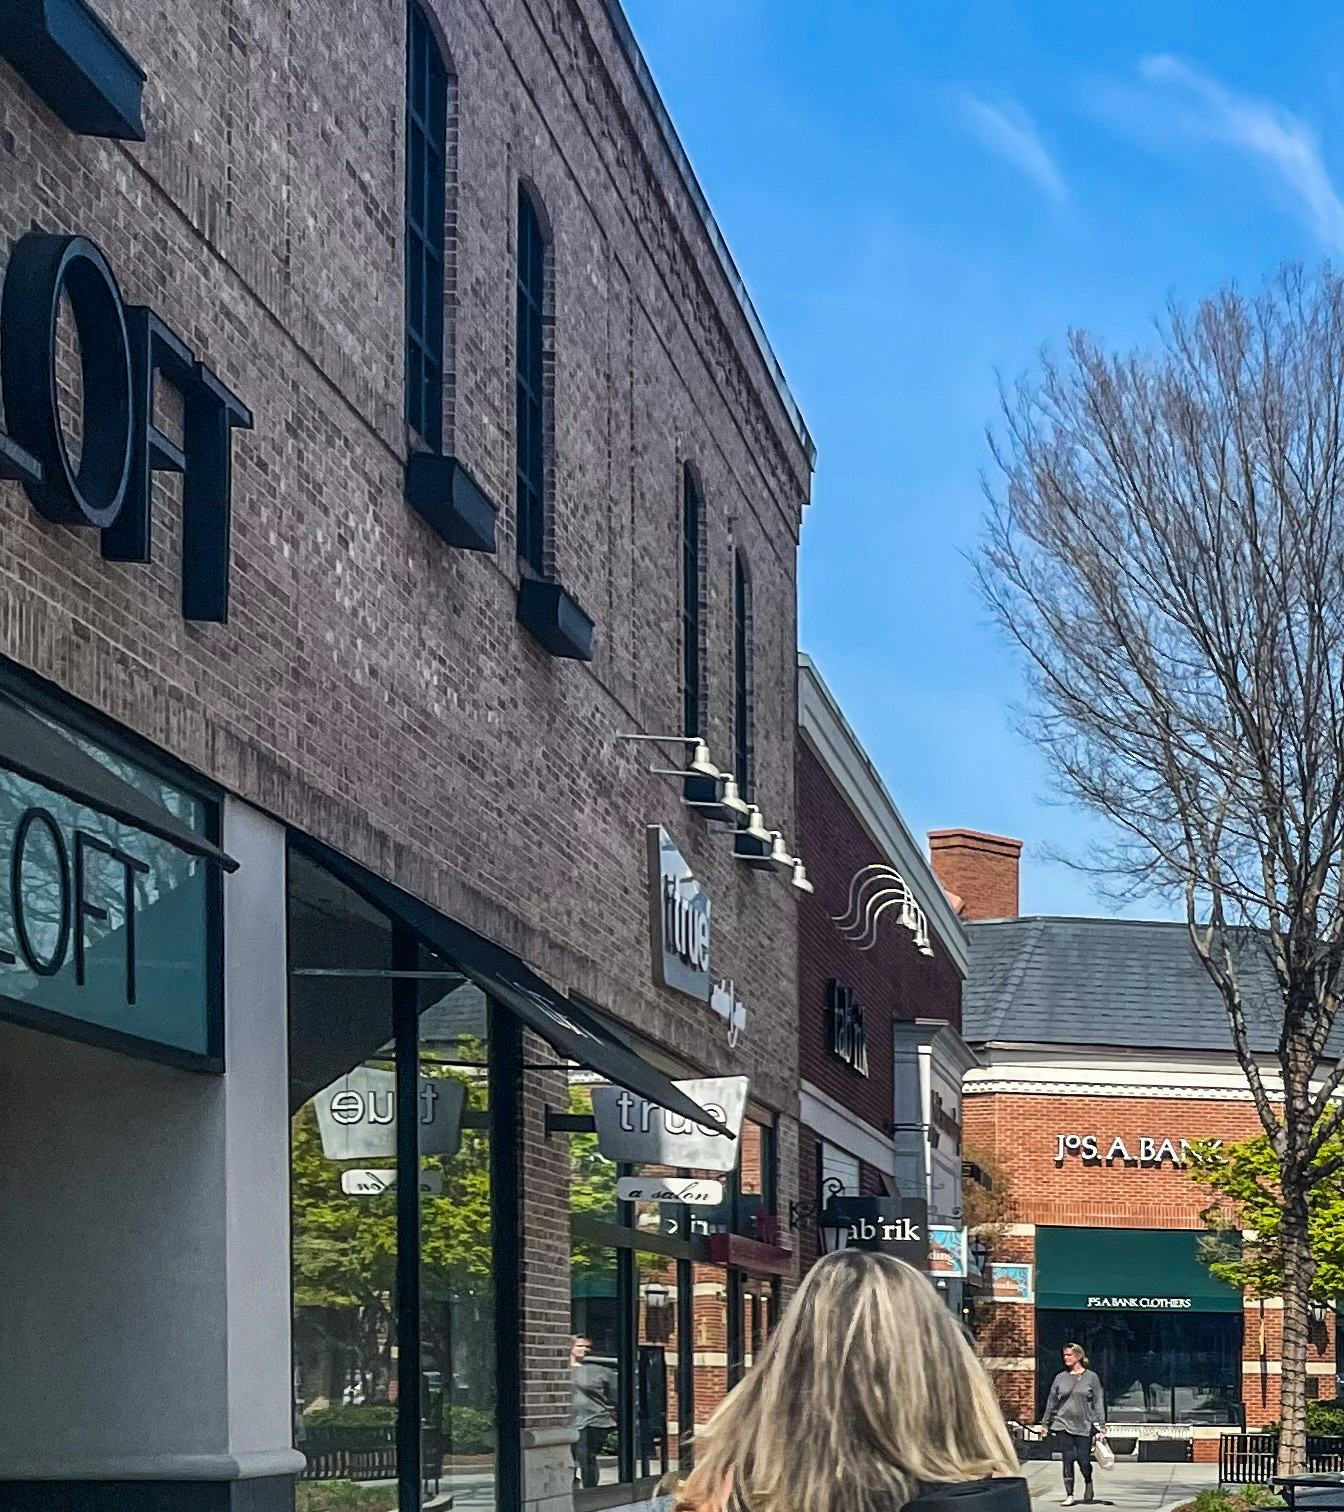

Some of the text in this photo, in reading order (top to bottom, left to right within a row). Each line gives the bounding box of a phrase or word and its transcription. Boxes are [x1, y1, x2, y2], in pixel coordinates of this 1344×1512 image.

[0, 807, 149, 1006] OFT
[664, 873, 709, 973] true
[628, 1181, 709, 1201] a salon
[848, 1216, 920, 1241] ab'rik
[1139, 1297, 1192, 1308] CLOTHIERS
